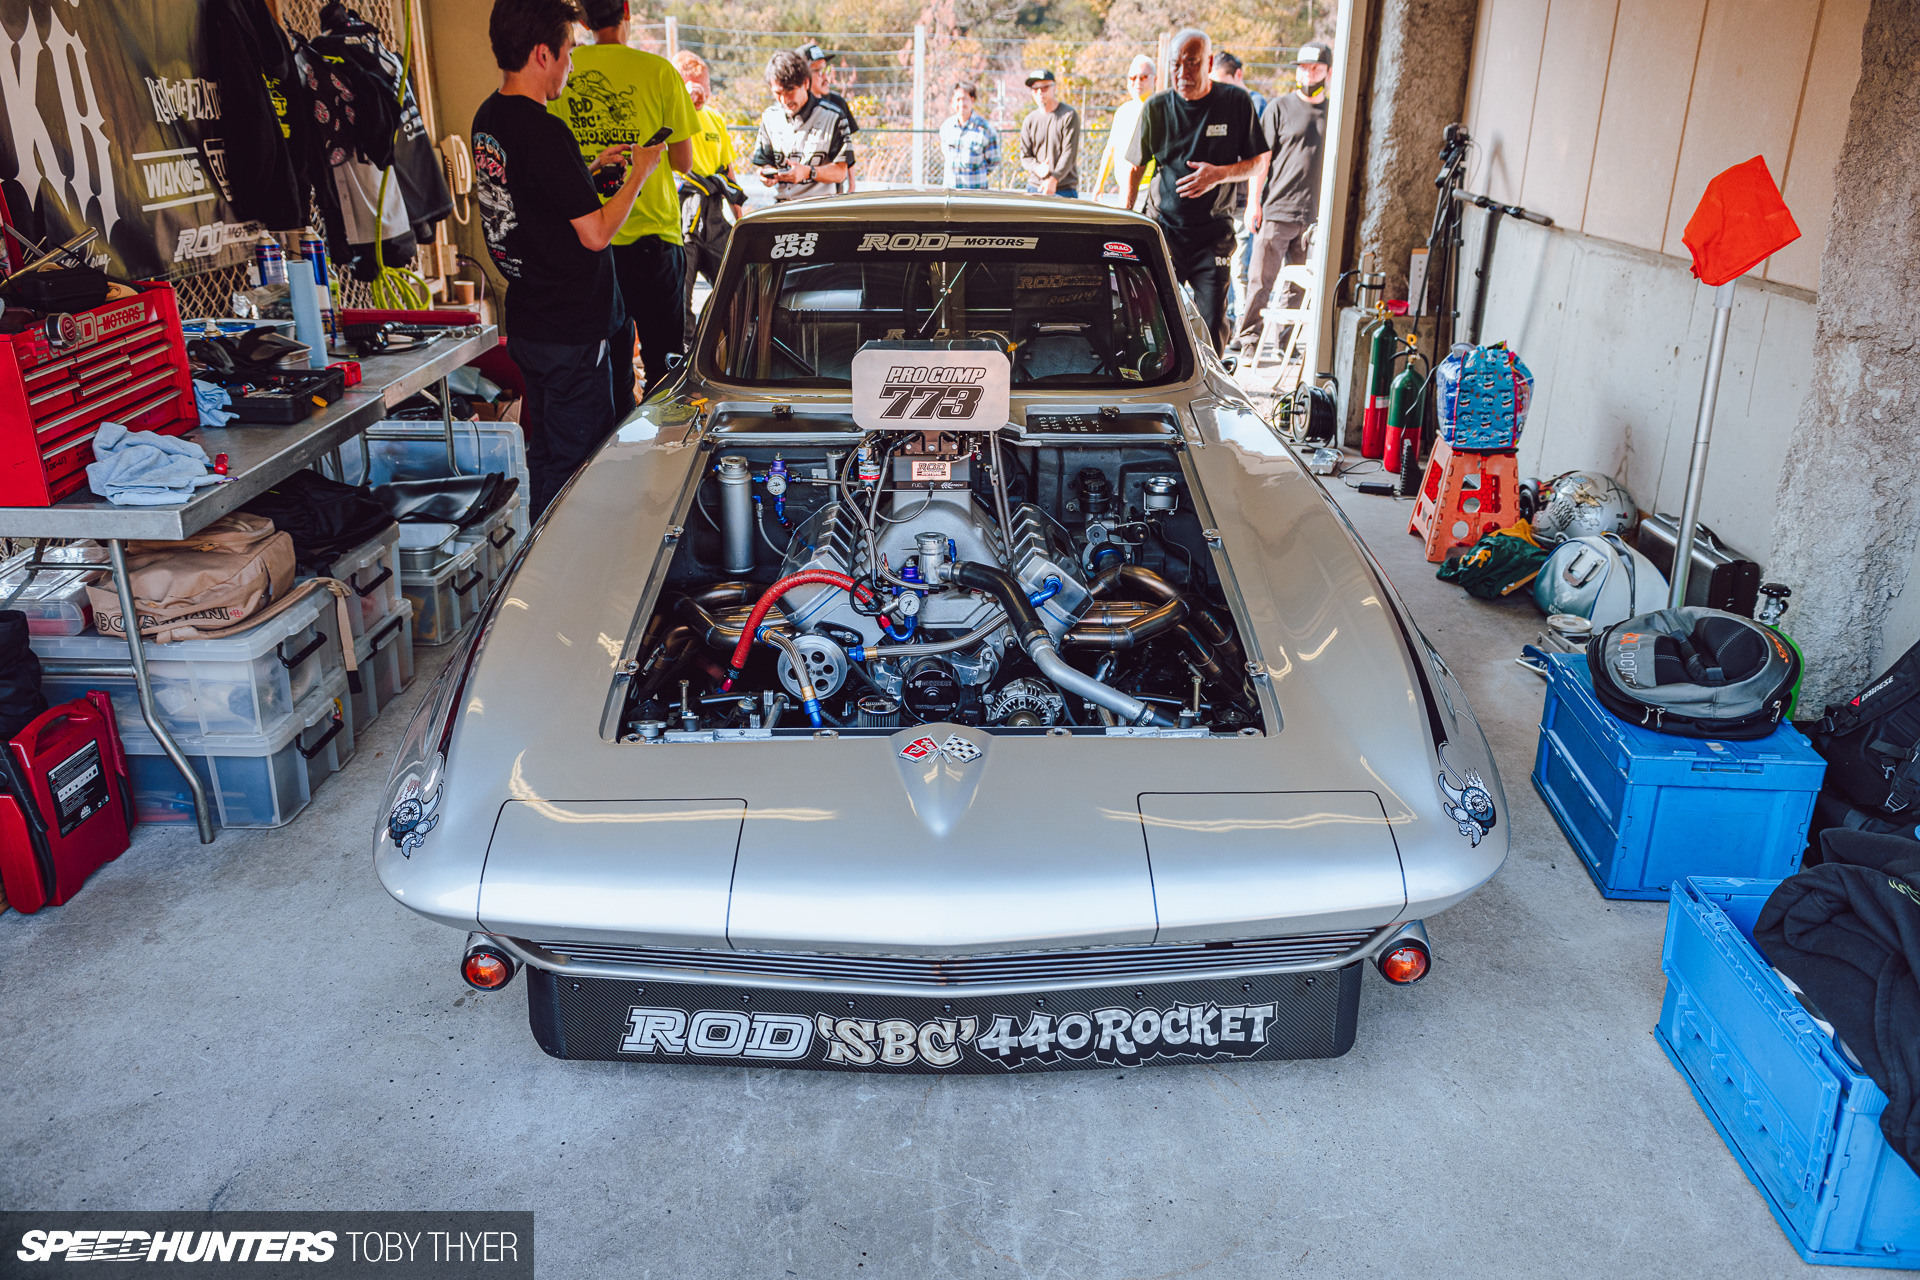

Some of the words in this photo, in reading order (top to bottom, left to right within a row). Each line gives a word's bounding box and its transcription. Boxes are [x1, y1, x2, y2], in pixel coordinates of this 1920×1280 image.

[568, 97, 593, 116] ROD
[595, 128, 640, 146] ROCKET
[774, 233, 819, 244] V8-R
[857, 233, 950, 251] ROD
[964, 238, 1025, 246] MOTORS
[770, 241, 816, 259] 658
[1017, 275, 1063, 289] ROD
[102, 306, 141, 331] MOTORS
[885, 366, 928, 384] PRO
[927, 366, 987, 384] COMP
[879, 384, 985, 420] 773
[618, 1006, 816, 1060] ROD
[977, 1012, 1096, 1064] 440
[1095, 1002, 1277, 1062] ROCKET
